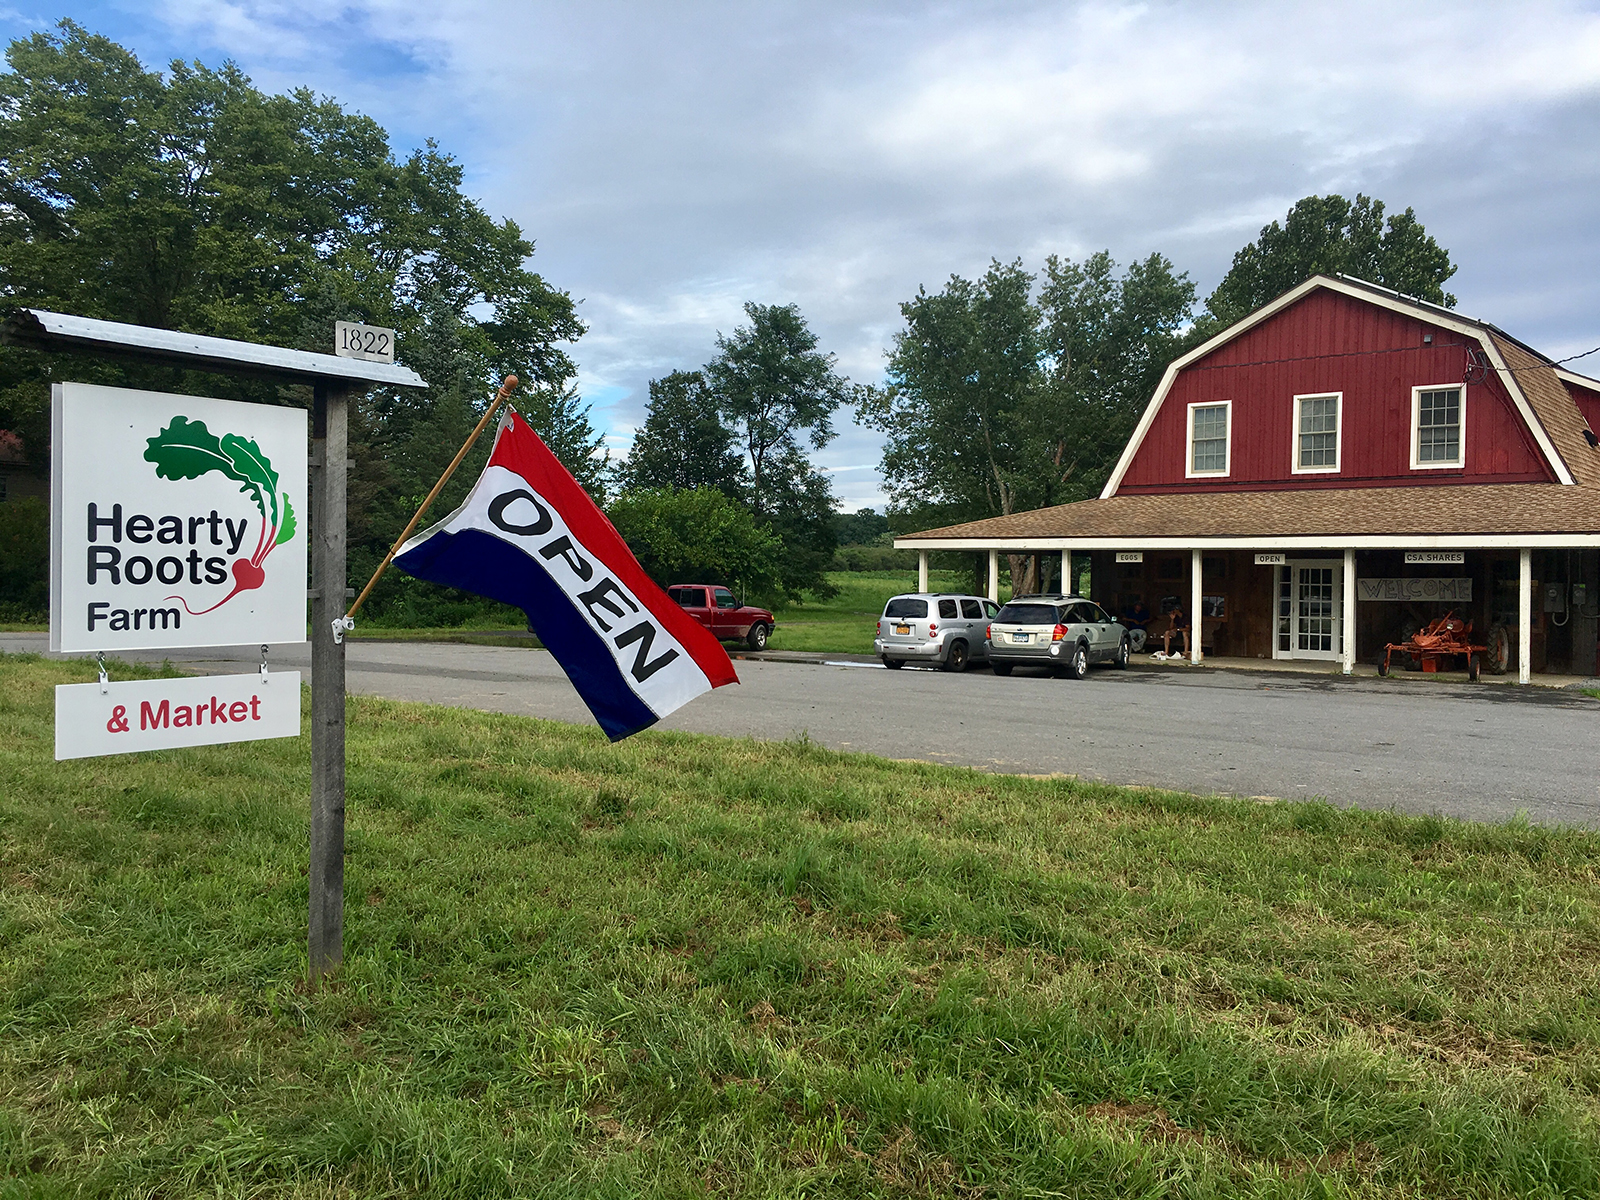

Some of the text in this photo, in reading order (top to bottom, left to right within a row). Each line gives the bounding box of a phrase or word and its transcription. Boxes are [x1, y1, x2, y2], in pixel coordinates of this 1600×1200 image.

[342, 327, 389, 356] 1822
[87, 502, 248, 555] Hearty
[87, 545, 228, 585] Roots
[1259, 555, 1281, 563] OPEN
[1406, 553, 1462, 561] CSA SHARES
[487, 488, 680, 684] OPEN
[1361, 579, 1470, 600] WELCOME
[87, 602, 181, 631] Farm
[106, 694, 262, 733] & Market
